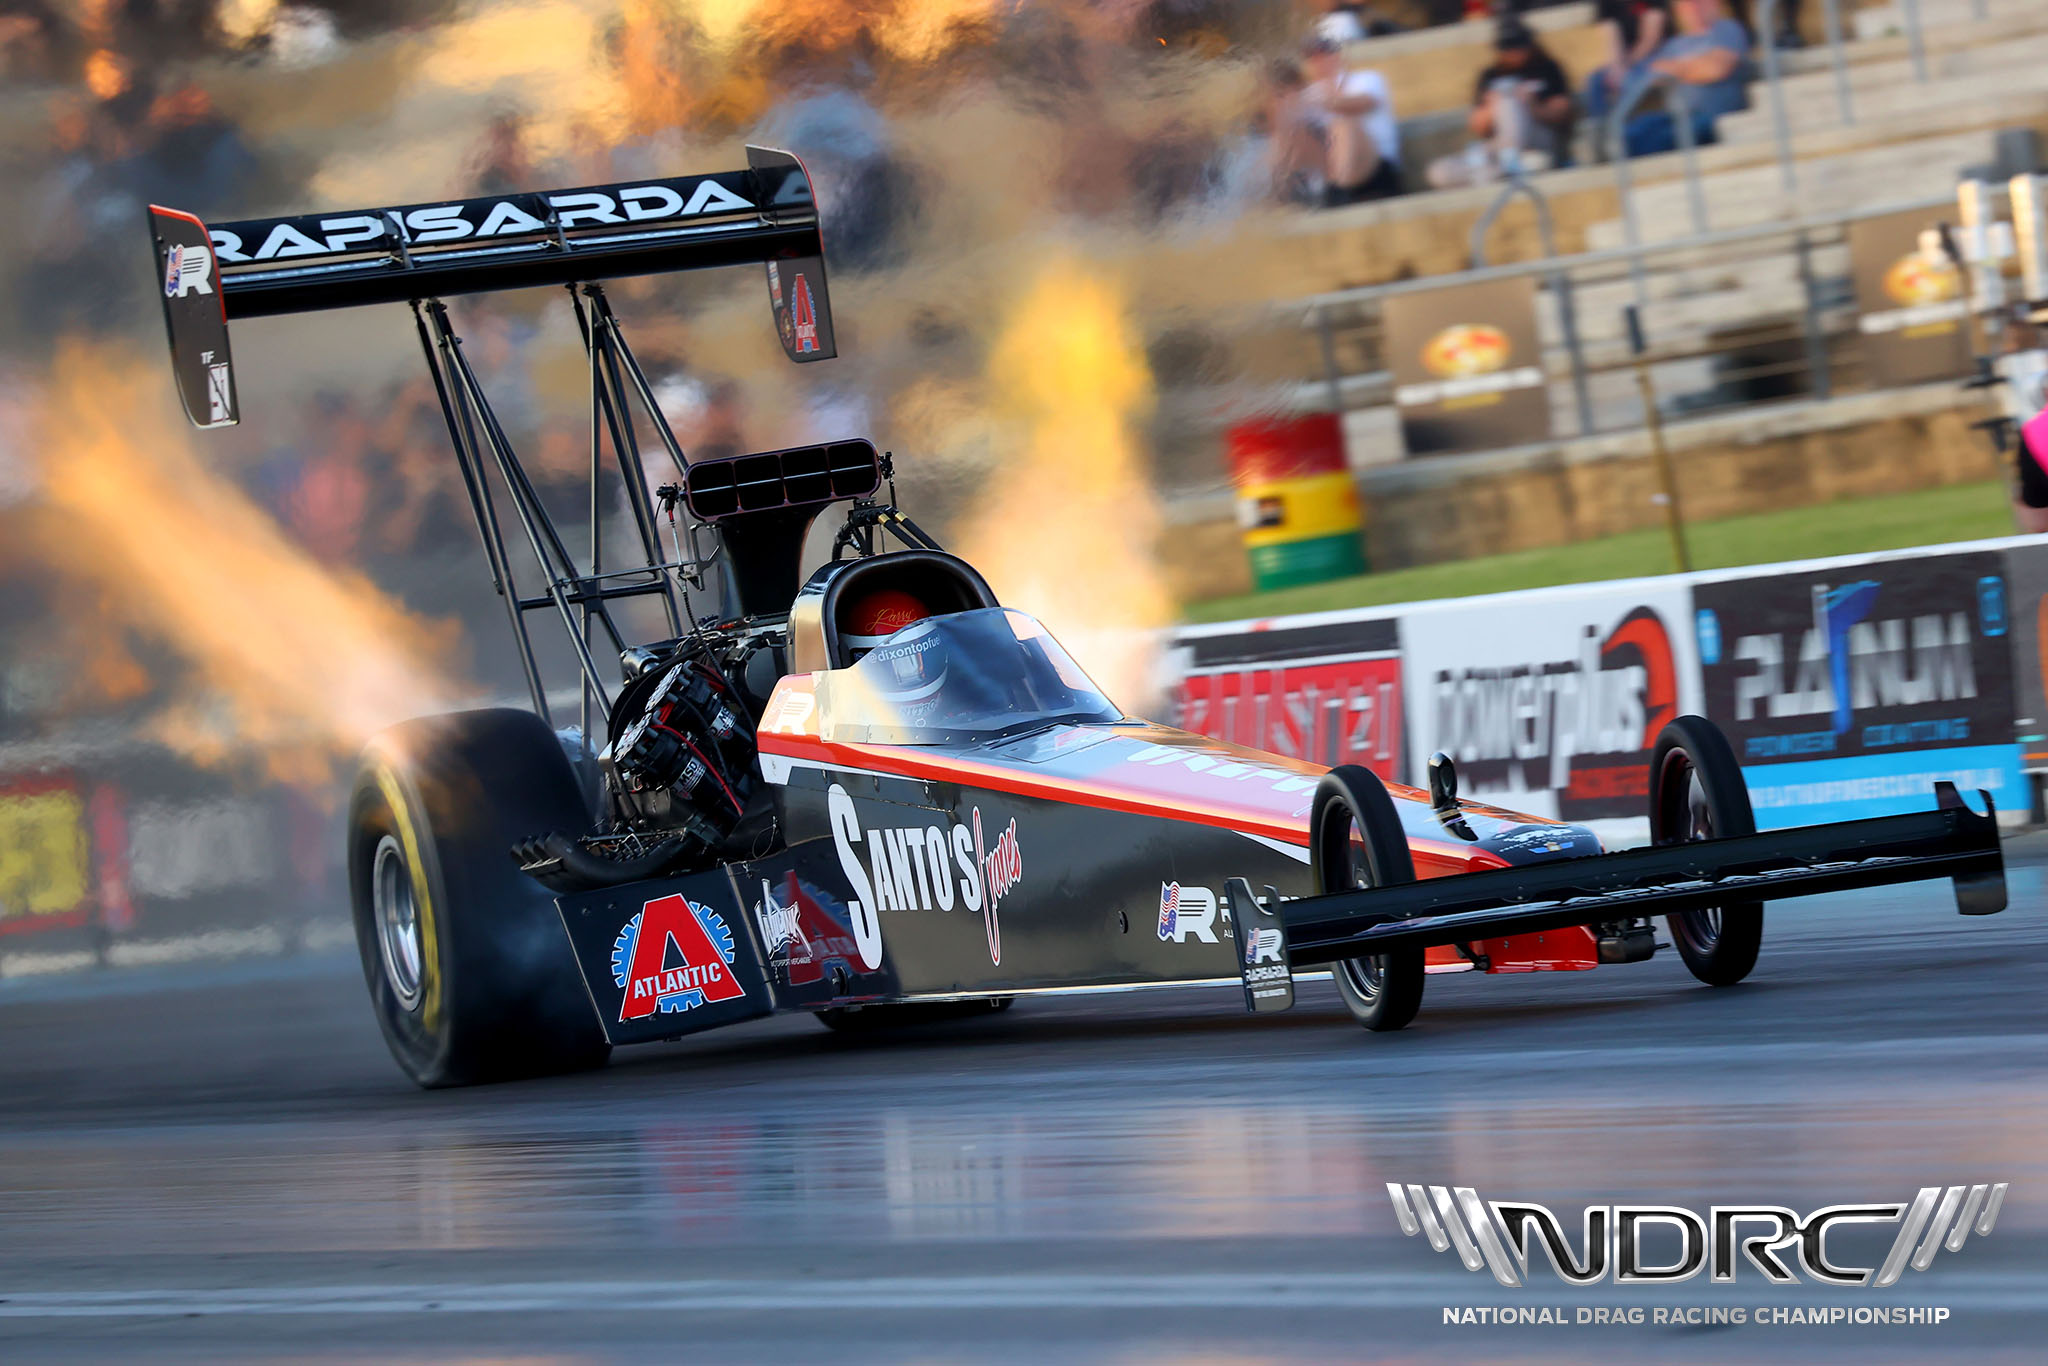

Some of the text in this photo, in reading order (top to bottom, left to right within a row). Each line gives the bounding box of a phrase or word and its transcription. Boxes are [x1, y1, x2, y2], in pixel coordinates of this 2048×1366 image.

[208, 178, 757, 262] RAPISARDA
[201, 351, 214, 364] TF
[827, 783, 983, 970] SANTO'S
[633, 961, 723, 1000] ATLANTIC
